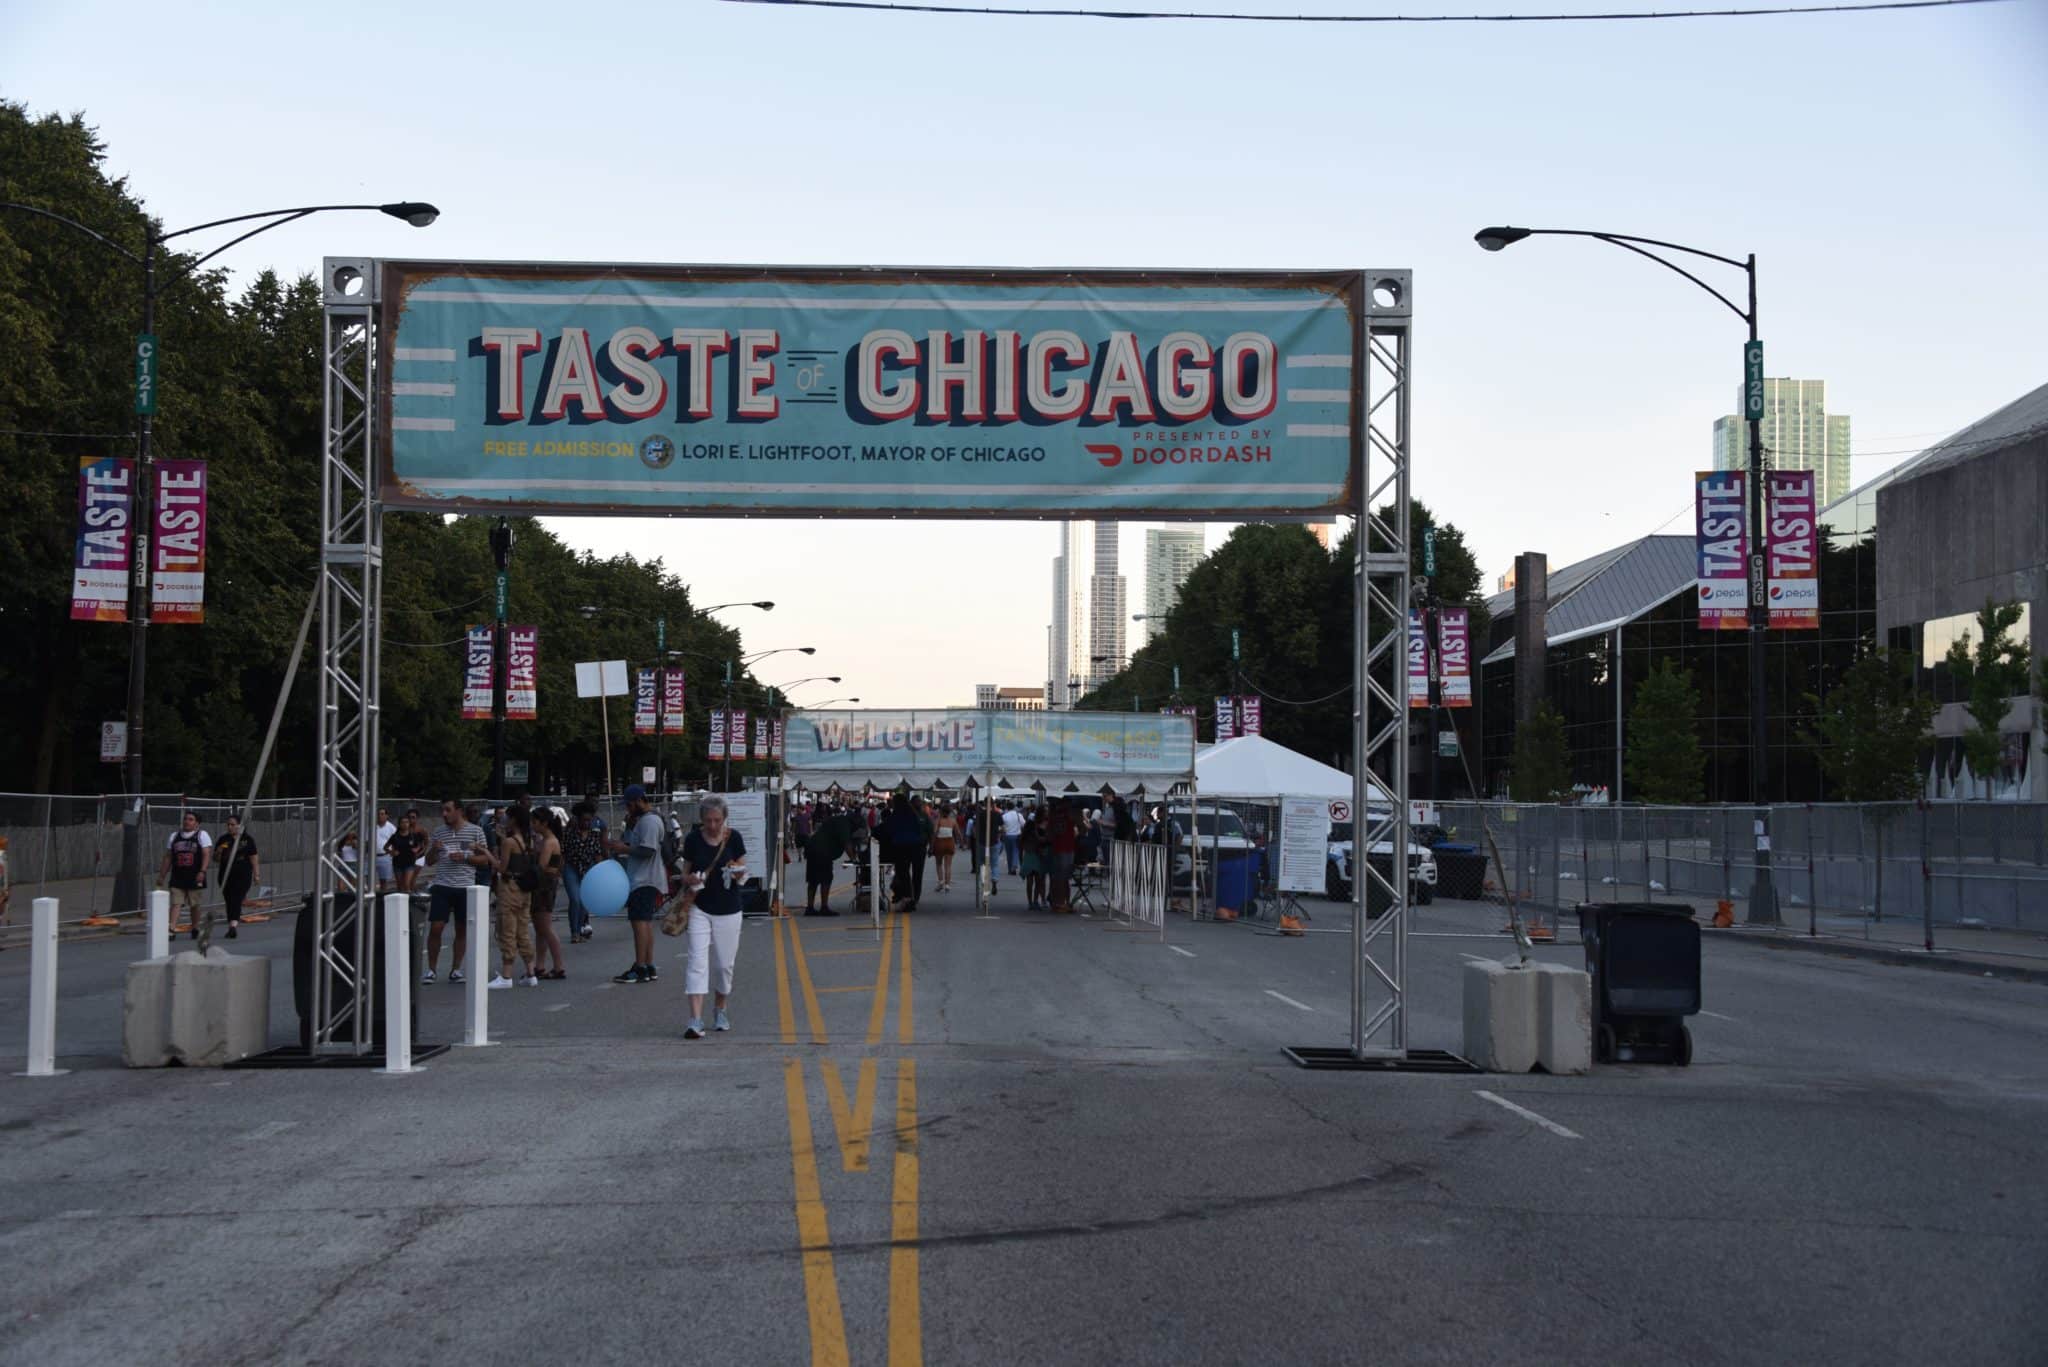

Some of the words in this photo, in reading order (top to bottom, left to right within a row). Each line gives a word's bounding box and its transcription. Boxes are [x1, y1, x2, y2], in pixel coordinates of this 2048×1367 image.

[137, 342, 153, 406] C121
[469, 327, 780, 426] TASTE
[797, 363, 825, 391] OF
[844, 329, 1278, 427] CHICAGO
[1749, 349, 1762, 411] C120
[484, 441, 528, 457] FREE
[532, 441, 635, 458] ADMISSION
[683, 444, 724, 460] LORI
[729, 445, 743, 460] E.
[749, 445, 856, 463] LIGHTFOOT,
[861, 446, 925, 462] MAYOR
[931, 447, 956, 462] OF
[961, 447, 1046, 462] CHICAGO
[1133, 430, 1240, 441] PRESENTED
[1251, 430, 1272, 440] BY
[1133, 446, 1272, 464] DOORDASH
[83, 467, 129, 567] TASTE
[159, 470, 201, 570] TASTE
[1701, 479, 1742, 577] TASTE
[1771, 478, 1812, 577] TASTE
[136, 537, 145, 585] C121
[90, 601, 98, 609] OF
[168, 604, 175, 612] OF
[1715, 588, 1744, 599] pepsi
[1785, 588, 1816, 599] pepsi
[467, 630, 492, 688] TASTE
[510, 631, 535, 689] TASTE
[1441, 614, 1467, 675] TASTE
[638, 672, 656, 713] TASTE
[665, 672, 682, 713] TASTE
[711, 712, 724, 744] TASTE
[732, 712, 745, 744] TASTE
[815, 719, 976, 753] WELCOME
[1080, 730, 1162, 746] CHICAGO
[1217, 699, 1233, 739] TASTE
[1418, 809, 1424, 823] 1
